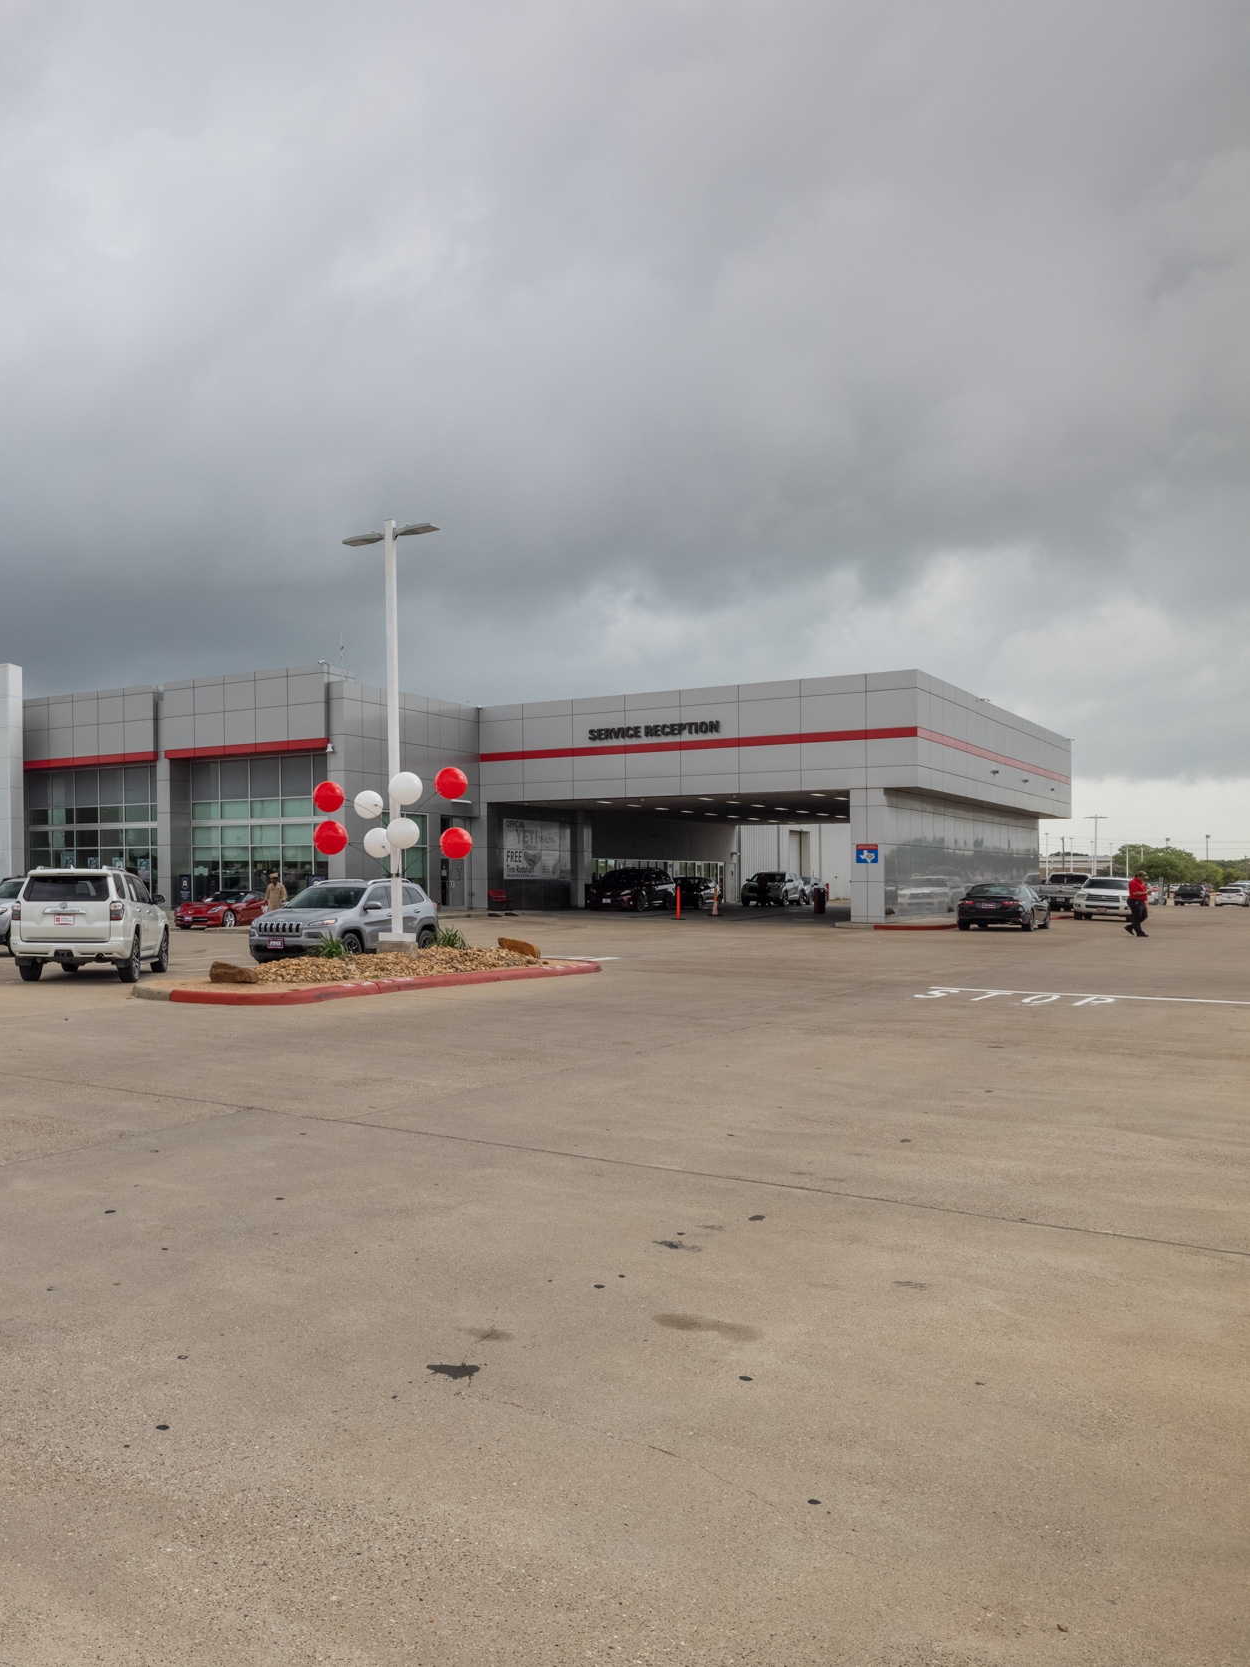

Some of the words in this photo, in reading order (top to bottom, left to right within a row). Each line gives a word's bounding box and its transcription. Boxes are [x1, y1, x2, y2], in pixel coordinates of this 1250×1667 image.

[587, 725, 642, 741] SERVICE
[644, 720, 720, 737] RECEPTION
[506, 820, 525, 828] OFFICIAL
[515, 829, 538, 845] YETI
[506, 850, 522, 862] FREE
[506, 865, 515, 873] Tire
[516, 865, 534, 873] Rotation
[913, 989, 1117, 1006] STOP
